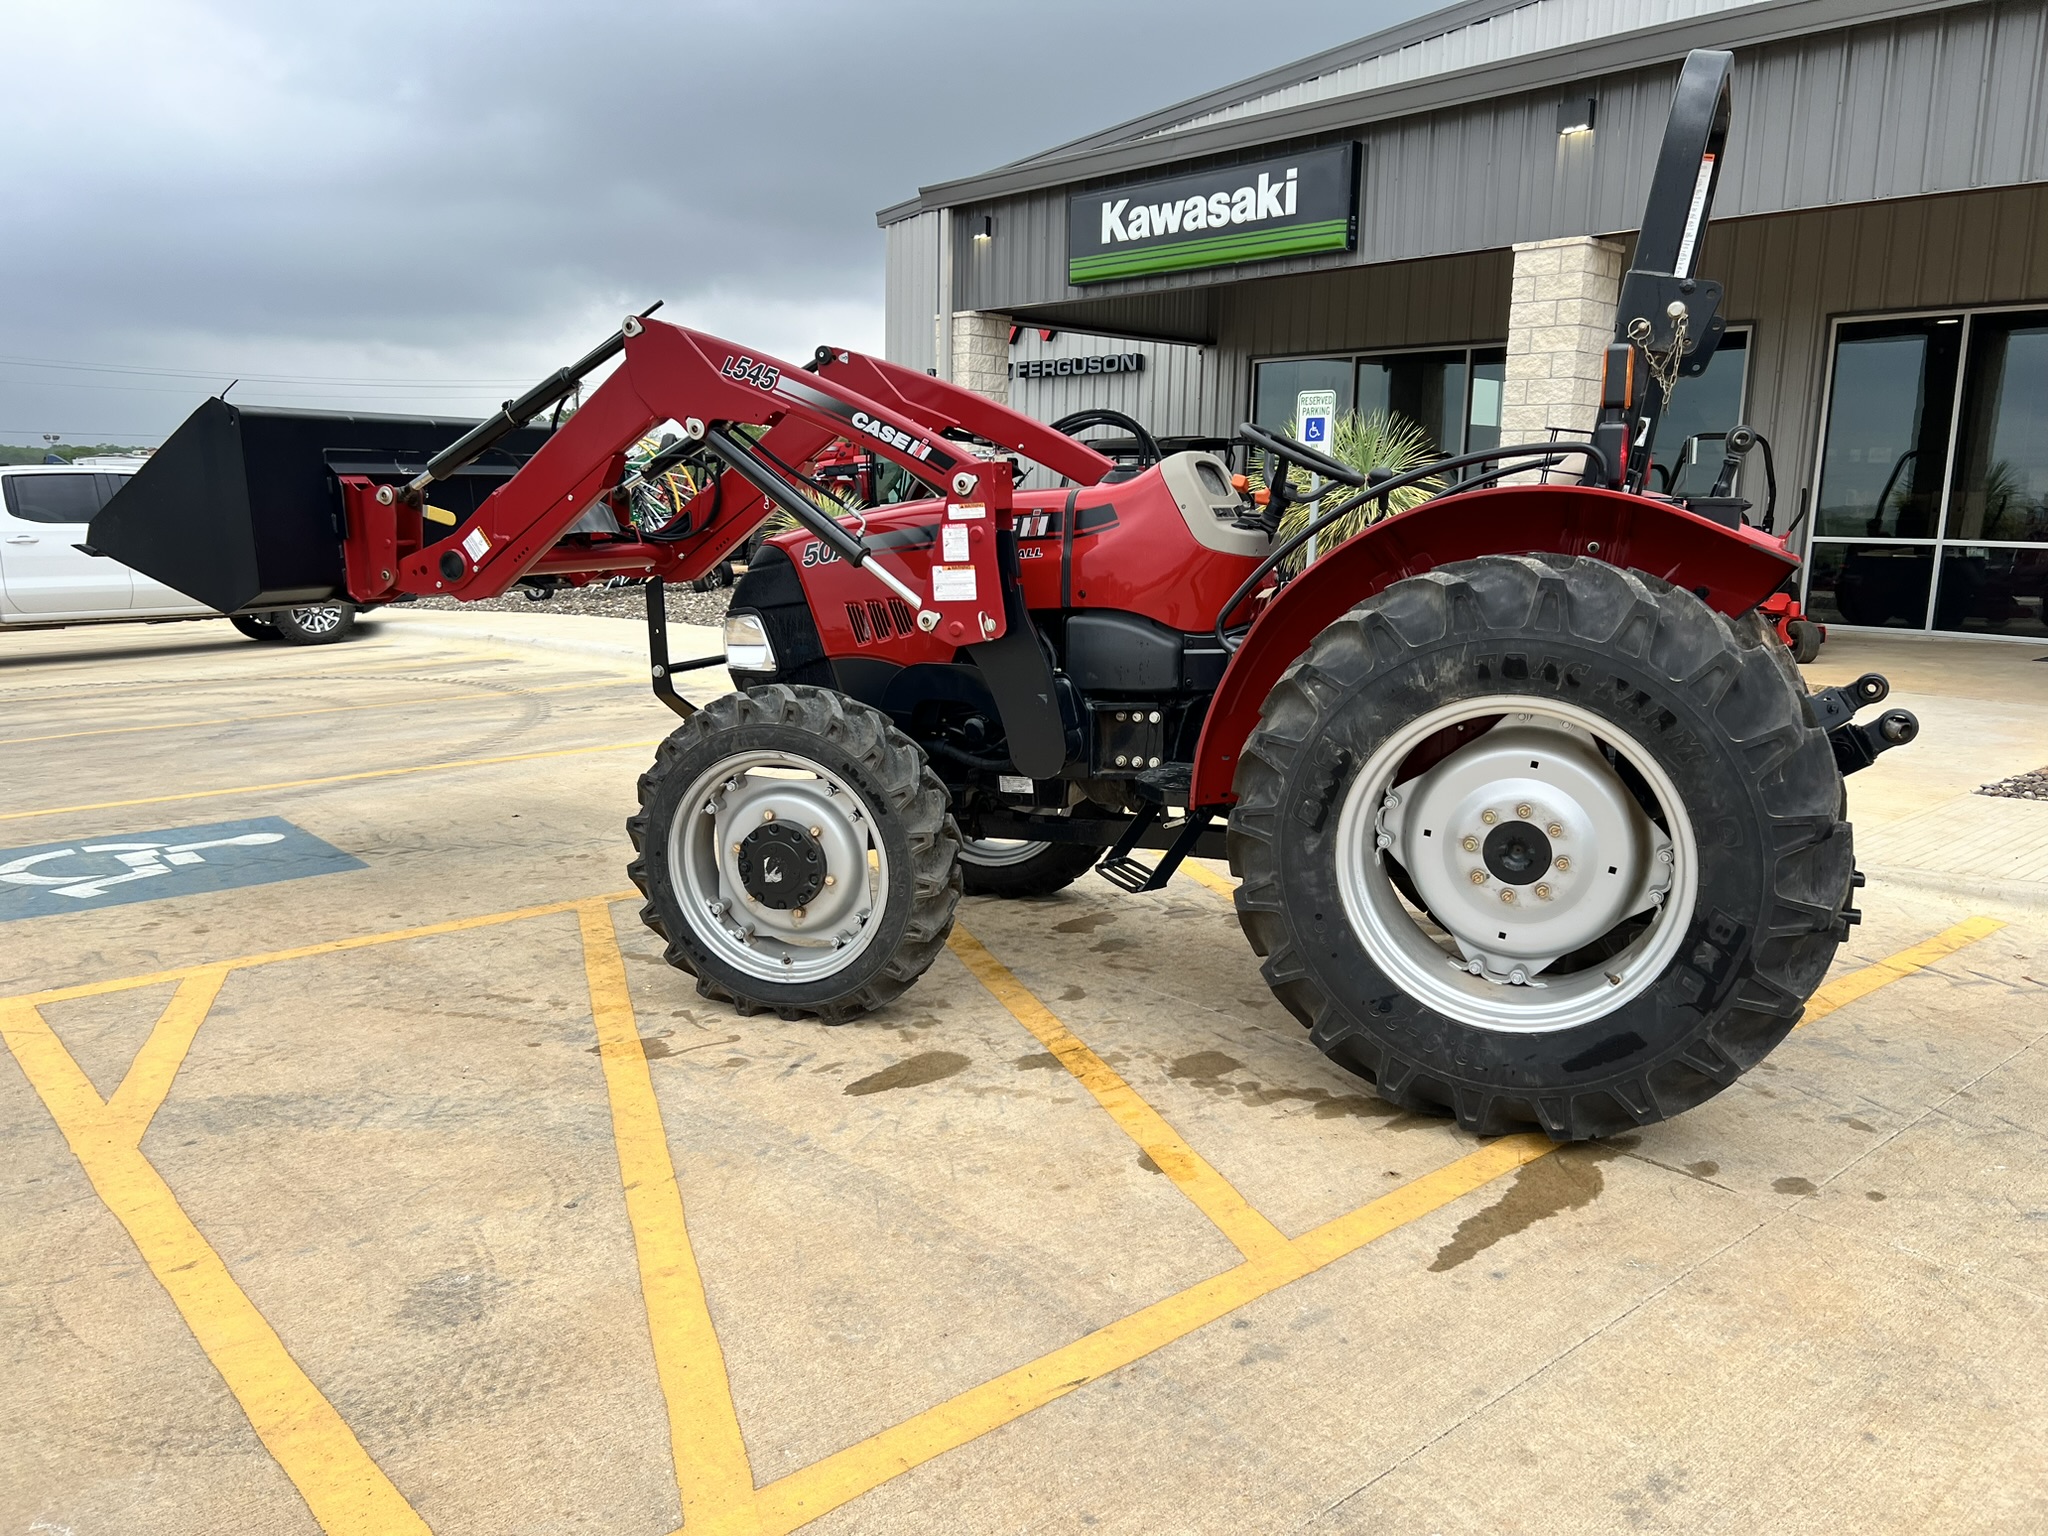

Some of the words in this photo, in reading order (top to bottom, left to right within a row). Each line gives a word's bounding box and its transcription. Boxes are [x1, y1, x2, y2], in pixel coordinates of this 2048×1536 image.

[1101, 168, 1298, 244] Kawasaki
[721, 355, 780, 391] L545
[1015, 353, 1140, 378] FERGUSON
[1301, 396, 1333, 405] RESERVED
[1302, 407, 1331, 415] PARKING
[852, 412, 911, 451] CASE
